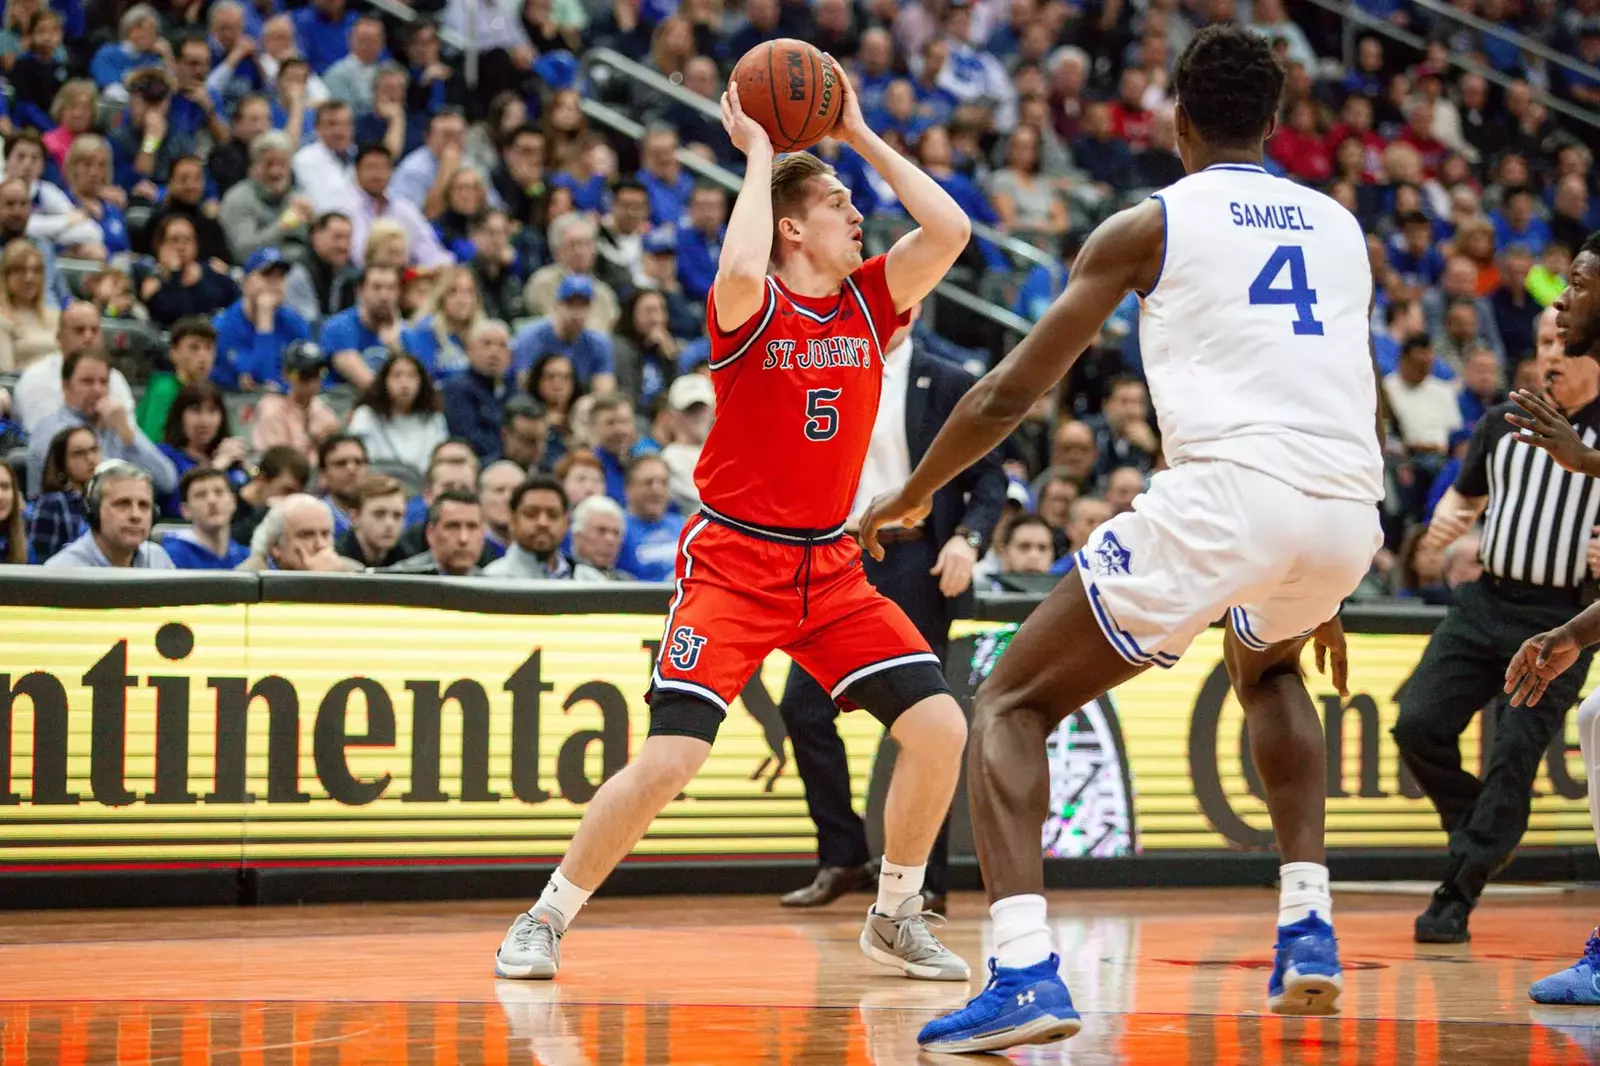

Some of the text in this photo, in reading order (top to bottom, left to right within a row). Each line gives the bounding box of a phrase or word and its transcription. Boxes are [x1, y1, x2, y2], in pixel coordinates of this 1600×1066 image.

[786, 51, 805, 101] NCAA
[817, 57, 837, 117] ilson
[1230, 202, 1314, 230] SAMUEL
[1248, 245, 1324, 336] 4
[763, 336, 870, 370] ST. JOHN'S
[804, 388, 842, 441] 5
[0, 622, 687, 807] ntinenta
